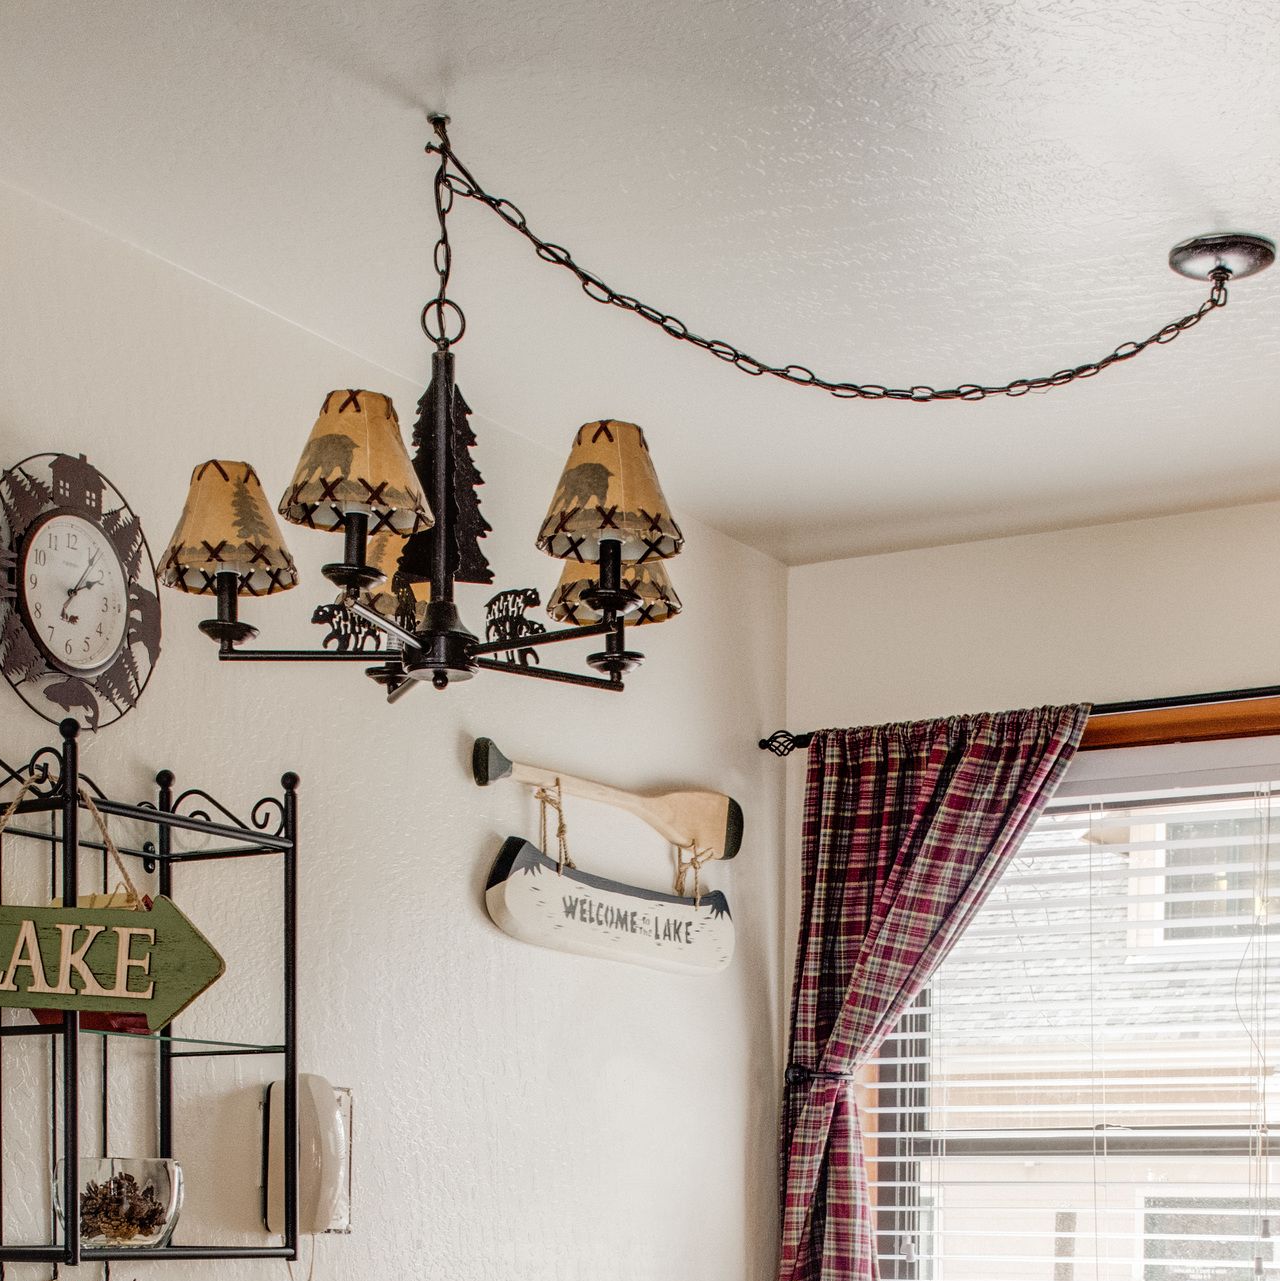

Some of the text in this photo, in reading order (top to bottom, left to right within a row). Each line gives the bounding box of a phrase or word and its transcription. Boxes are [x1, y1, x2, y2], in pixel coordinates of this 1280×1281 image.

[48, 532, 58, 551] 11
[66, 532, 78, 551] 12
[34, 548, 46, 567] 10
[29, 573, 38, 590] 9
[33, 602, 42, 619] 8
[101, 597, 109, 613] 3
[48, 625, 55, 641] 7
[95, 622, 103, 637] 4
[64, 639, 72, 655] 6
[82, 636, 90, 652] 5
[562, 895, 638, 934] WELCOME
[654, 916, 693, 945] LAKE
